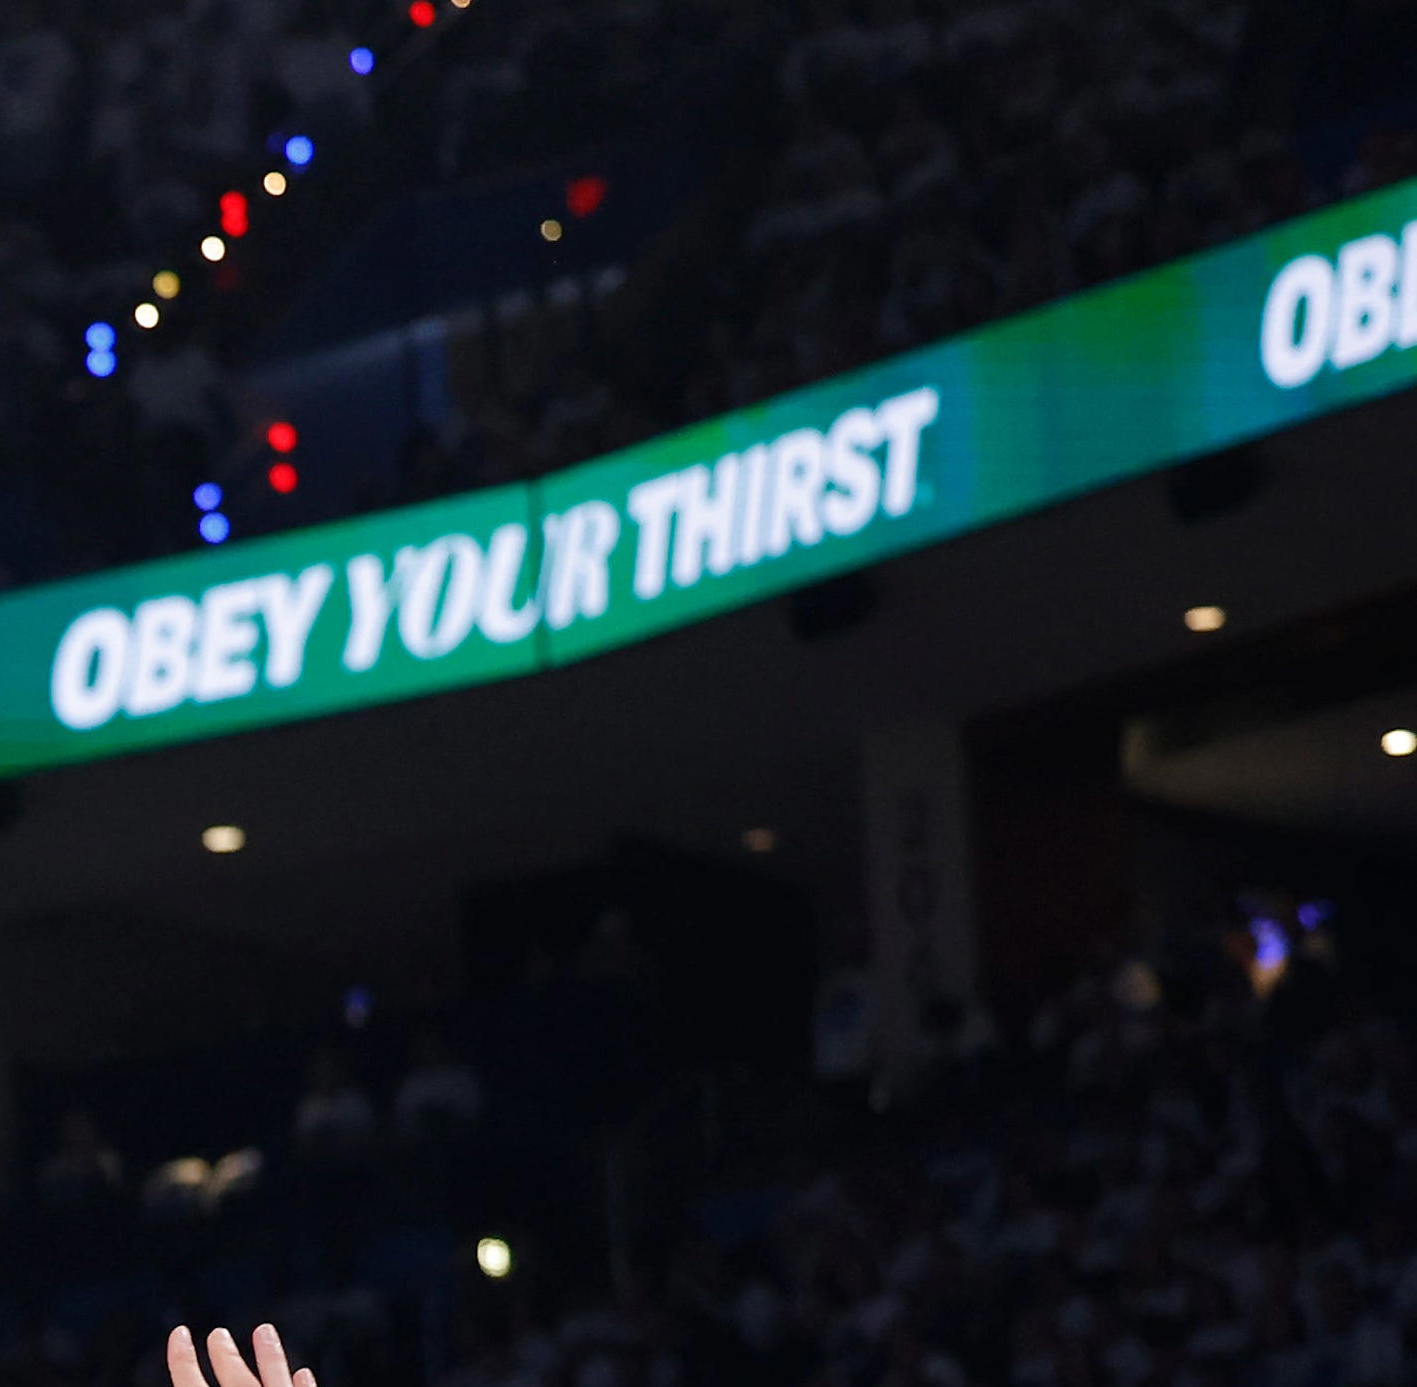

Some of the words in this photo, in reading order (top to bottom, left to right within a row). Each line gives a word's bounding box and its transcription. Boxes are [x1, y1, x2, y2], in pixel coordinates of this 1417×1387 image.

[1260, 219, 1417, 389] OB
[50, 562, 333, 730] OBEY
[340, 501, 620, 672] YOUR
[625, 386, 940, 600] THIRST
